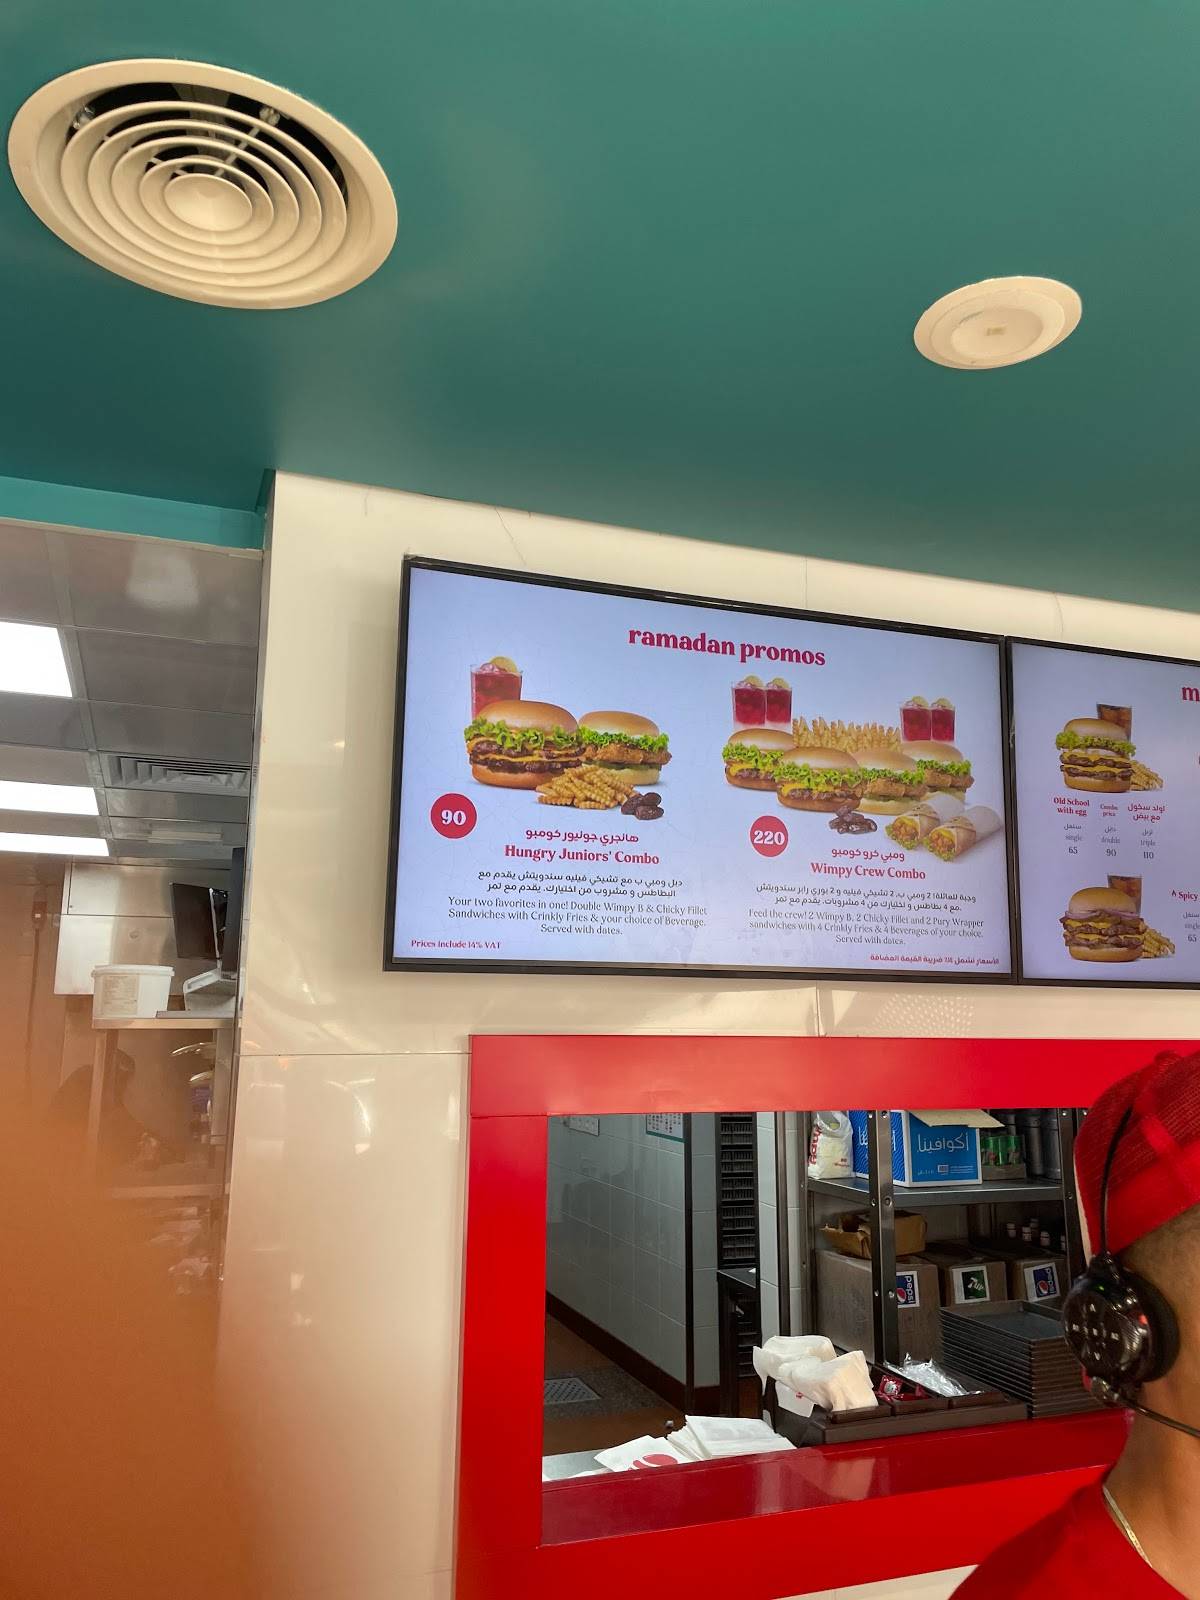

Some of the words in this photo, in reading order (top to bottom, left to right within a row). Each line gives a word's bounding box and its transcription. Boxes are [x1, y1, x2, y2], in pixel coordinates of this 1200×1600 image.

[628, 629, 735, 656] ramadan
[740, 643, 826, 666] promos
[1053, 797, 1066, 805] Old
[1066, 798, 1090, 807] School
[1057, 807, 1074, 815] with
[1075, 809, 1088, 817] egg
[1132, 813, 1149, 821] بيض
[441, 809, 467, 826] 90
[1150, 815, 1161, 823] مع
[525, 829, 561, 840] كومبو
[561, 830, 598, 843] جونيور
[600, 833, 639, 846] هانجري
[753, 830, 786, 846] 220
[504, 844, 557, 863] Hungry
[558, 847, 612, 862] Juniors'
[614, 851, 660, 864] Combo
[832, 848, 861, 858] كومبو
[863, 849, 879, 860] كرو
[1068, 846, 1078, 854] 65
[1106, 849, 1117, 857] 90
[1143, 851, 1155, 859] 110
[880, 851, 905, 863] ومبي
[478, 871, 491, 880] مع
[493, 871, 516, 880] يقدم
[518, 870, 563, 881] سندويتش
[811, 862, 852, 878] Wimpy
[855, 865, 885, 877] Crew
[887, 867, 926, 880] Combo
[487, 882, 502, 892] تمر
[620, 877, 633, 887] مع
[634, 878, 643, 886] ب
[644, 878, 666, 888] ومبي
[667, 879, 683, 888] دبل
[503, 884, 517, 894] مع
[518, 883, 541, 893] يقدم
[578, 886, 592, 895] من
[593, 887, 628, 897] مشروب
[637, 888, 676, 898] البطاطس
[756, 883, 796, 893] سندويتش
[629, 889, 635, 898] و
[1178, 891, 1199, 902] Spicy
[448, 896, 472, 906] Your
[474, 897, 493, 907] two
[495, 897, 536, 908] favorites
[538, 900, 547, 909] in
[549, 901, 568, 909] one!
[570, 901, 601, 911] Double
[604, 902, 636, 914] Wimpy
[638, 904, 644, 912] B
[645, 904, 654, 913] &
[656, 904, 685, 916] Chicky
[687, 906, 708, 915] Fillet
[788, 897, 800, 907] مع
[801, 897, 821, 907] يقدم
[867, 901, 879, 909] من
[448, 908, 506, 919] Sandwiches
[508, 910, 528, 920] with
[530, 911, 564, 923] Crinkly
[566, 912, 588, 922] Fries
[590, 913, 599, 922] &
[600, 915, 622, 925] your
[624, 914, 652, 925] choice
[653, 915, 664, 925] of
[664, 916, 706, 928] Beverage.
[748, 908, 768, 918] Feed
[769, 909, 783, 919] the
[784, 911, 807, 919] crew!
[808, 911, 814, 919] 2
[816, 911, 845, 923] Wimpy
[856, 913, 861, 921] 2
[863, 912, 889, 925] Chicky
[891, 914, 908, 924] Fillet
[910, 915, 925, 925] and
[926, 917, 931, 925] 2
[952, 918, 984, 929] Wrapper
[541, 923, 572, 933] Served
[574, 924, 594, 934] with
[596, 925, 623, 935] dates.
[749, 920, 796, 930] sandwiches
[798, 921, 816, 931] with
[824, 922, 852, 934] Crinkly
[854, 923, 873, 933] Fries
[874, 925, 882, 933] &
[883, 925, 889, 933] 4
[890, 926, 929, 937] Beverages
[930, 927, 939, 936] of
[939, 929, 957, 938] your
[958, 929, 984, 939] choice.
[835, 935, 863, 944] Served
[865, 935, 881, 944] with
[883, 936, 906, 945] dates.
[1187, 934, 1198, 942] 65
[411, 939, 436, 948] Prices
[437, 940, 467, 948] Include
[468, 941, 483, 949] 14%
[484, 941, 501, 949] VAT
[916, 1131, 969, 1154] أكوافينا
